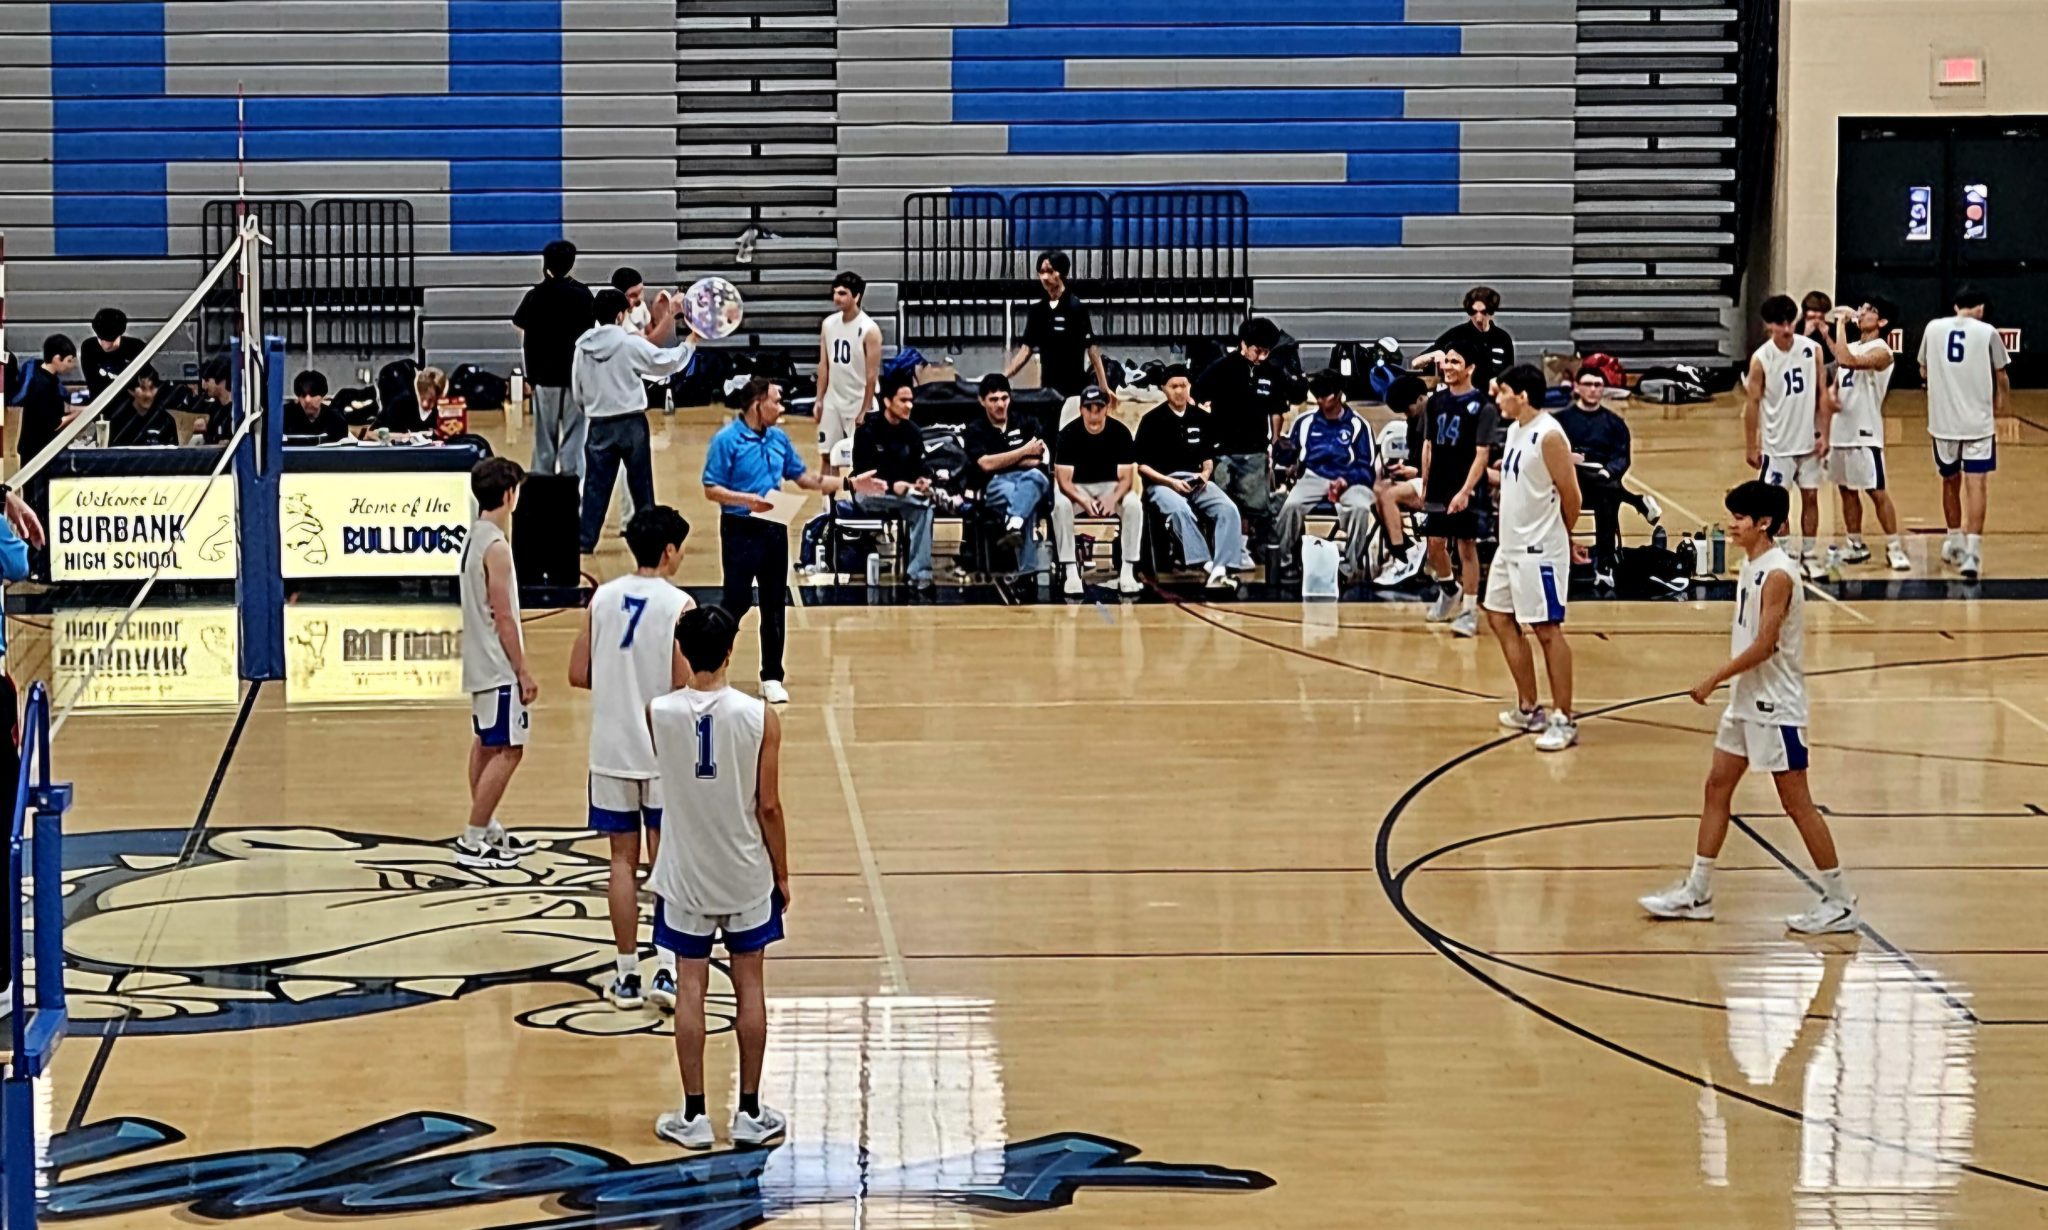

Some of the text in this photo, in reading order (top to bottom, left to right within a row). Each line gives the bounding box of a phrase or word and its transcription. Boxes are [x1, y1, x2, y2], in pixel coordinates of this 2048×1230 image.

[833, 338, 851, 364] 10
[1948, 330, 1966, 362] 6
[1784, 367, 1804, 397] 15
[1437, 413, 1460, 446] 14
[349, 496, 451, 517] Home of the
[59, 514, 186, 544] BURBANK
[343, 525, 467, 555] BULLDOGS
[64, 551, 182, 570] HIGH SCHOOL
[619, 593, 649, 650] 7
[695, 713, 717, 779] 1
